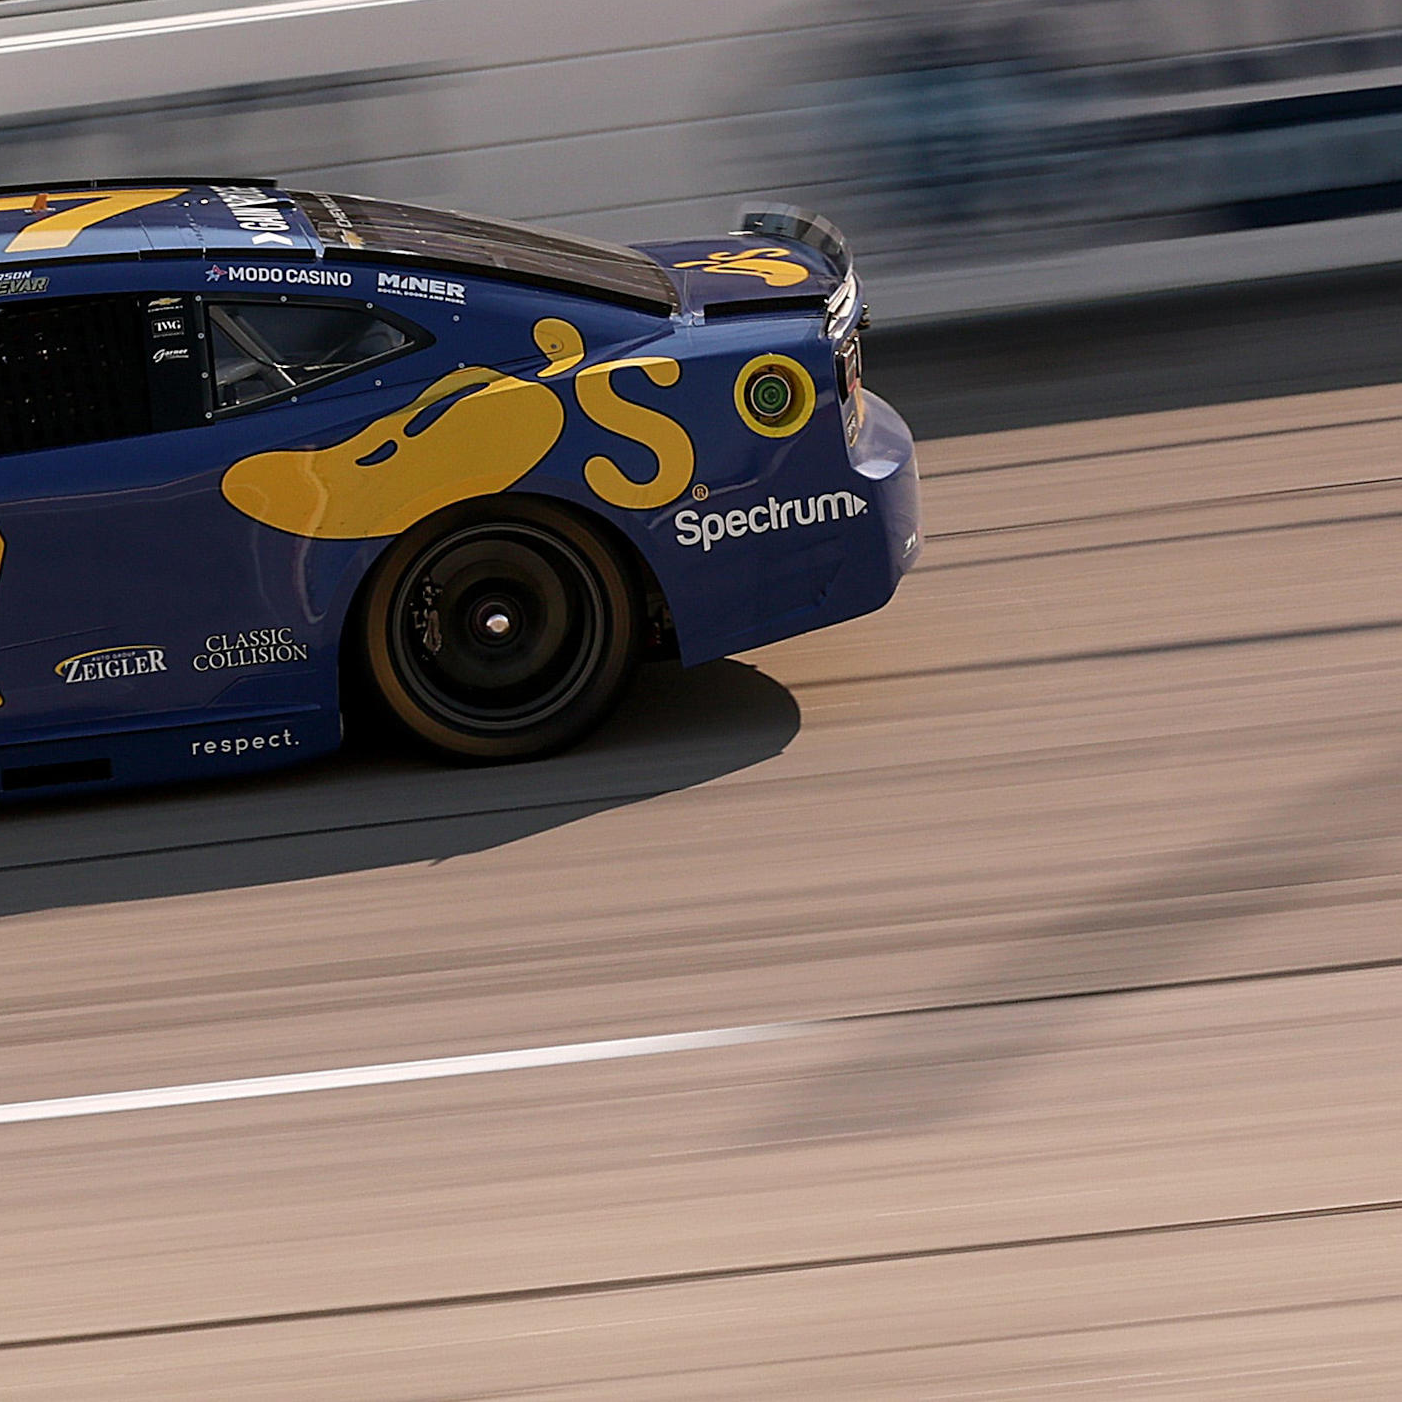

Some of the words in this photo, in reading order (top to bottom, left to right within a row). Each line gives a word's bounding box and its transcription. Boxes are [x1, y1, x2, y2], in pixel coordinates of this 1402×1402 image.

[229, 266, 283, 283] MODO
[285, 269, 352, 286] CASINO
[378, 272, 465, 298] MINER
[675, 491, 854, 551] Spectrum
[205, 627, 294, 653] CLASSIC
[65, 649, 167, 684] ZEIGLER
[193, 644, 308, 671] COLLISION
[192, 729, 300, 755] respect.
